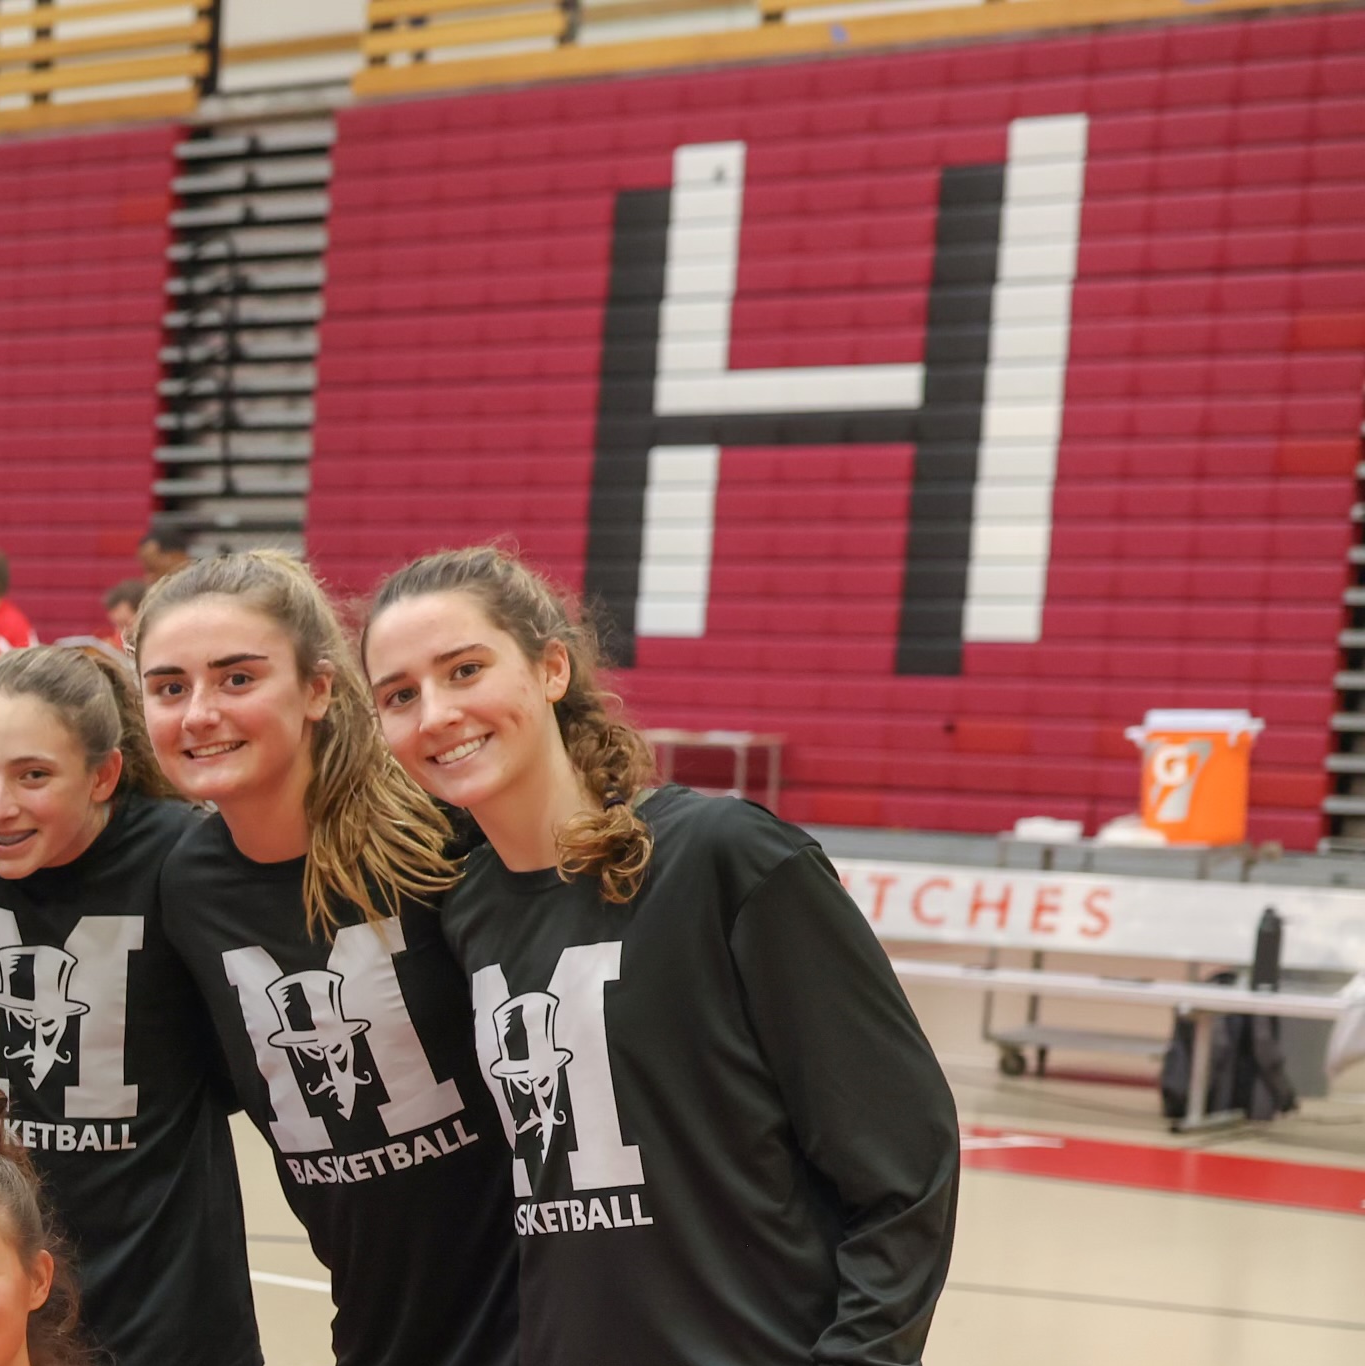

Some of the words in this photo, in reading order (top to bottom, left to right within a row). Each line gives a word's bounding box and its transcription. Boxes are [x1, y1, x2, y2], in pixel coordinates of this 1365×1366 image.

[609, 112, 1089, 655] H
[840, 873, 1113, 940] TCHES
[3, 1119, 137, 1152] KETBALL
[286, 1119, 479, 1185] BASKETBALL
[514, 1194, 653, 1236] SKETBALL
